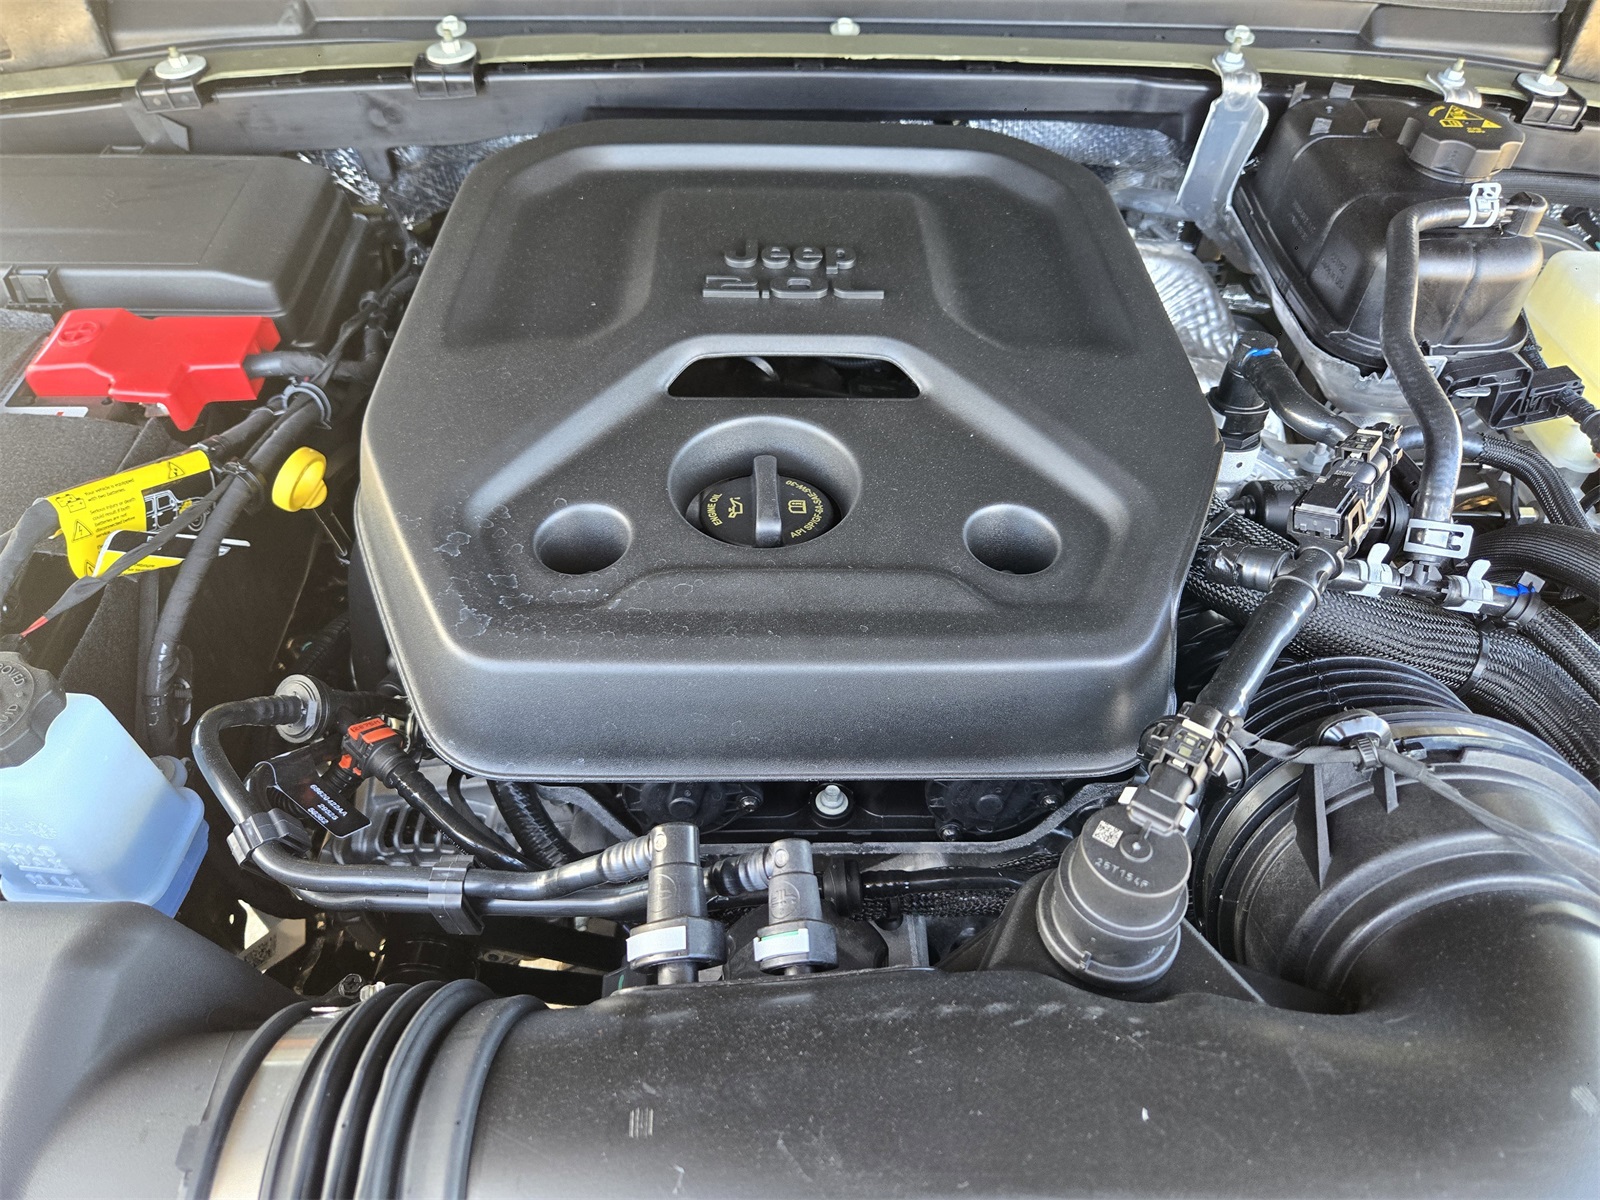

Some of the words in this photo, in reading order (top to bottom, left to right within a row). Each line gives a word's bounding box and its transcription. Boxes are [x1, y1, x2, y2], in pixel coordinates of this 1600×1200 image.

[724, 238, 857, 275] Jeep
[702, 275, 885, 300] 2.0L
[709, 493, 723, 503] OIL
[706, 502, 723, 526] ENGINE
[790, 529, 807, 539] API
[0, 663, 26, 687] OVED
